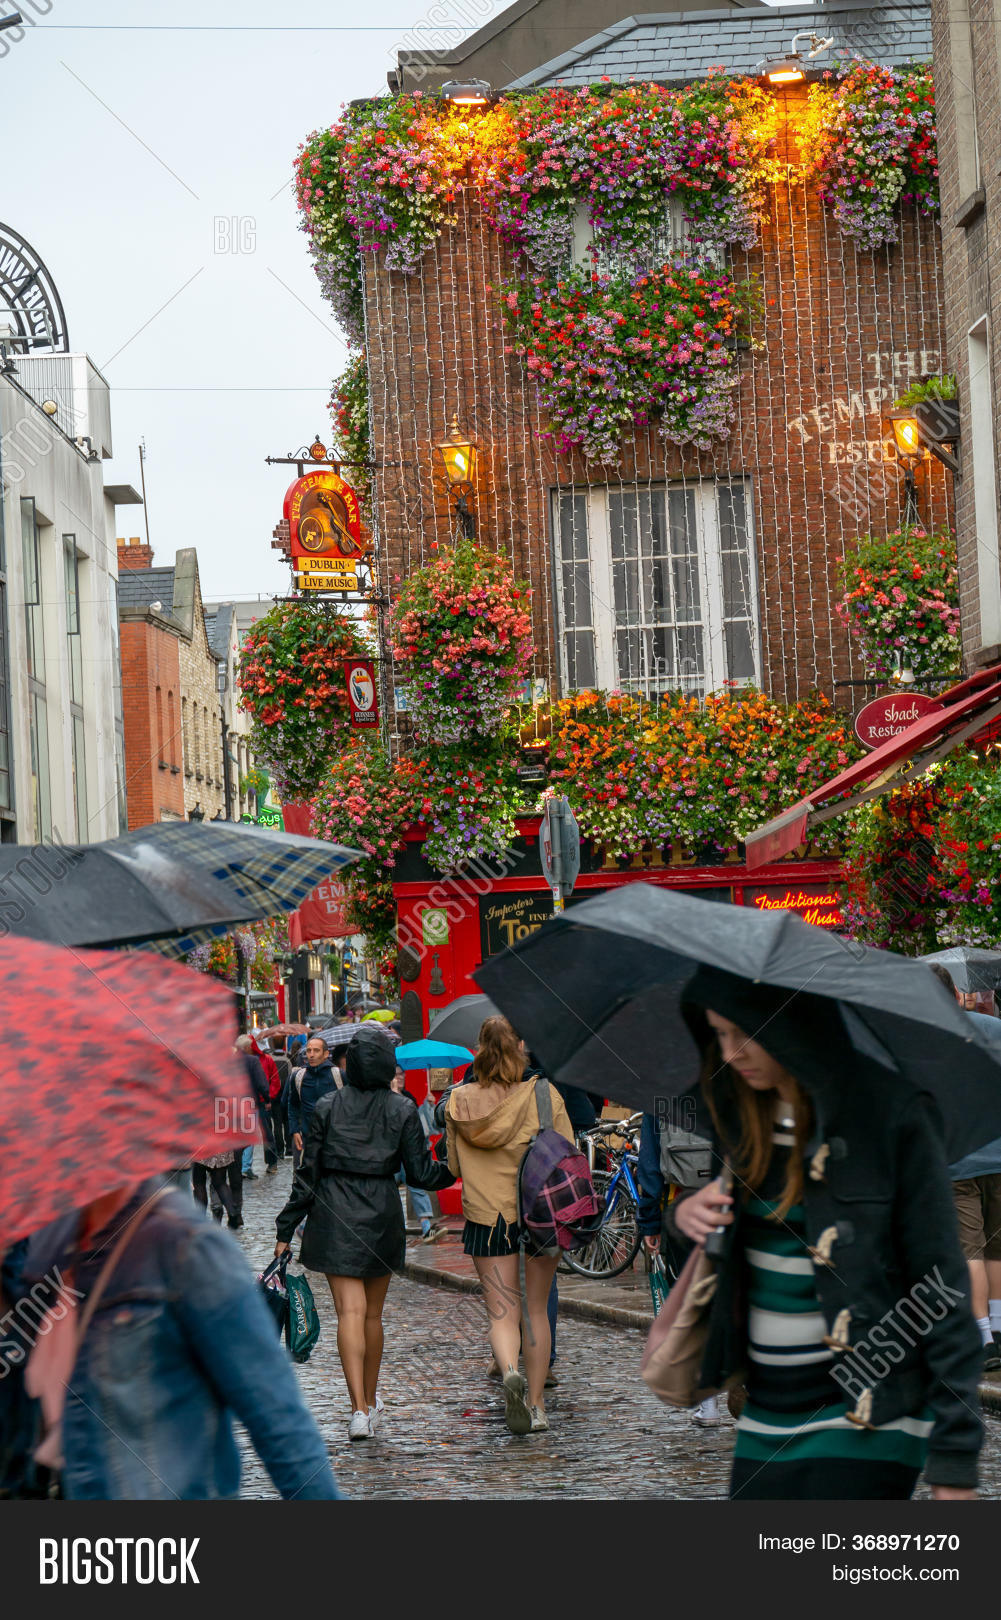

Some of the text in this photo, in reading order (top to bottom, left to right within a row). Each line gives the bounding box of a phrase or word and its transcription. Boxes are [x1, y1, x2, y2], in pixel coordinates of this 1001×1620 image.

[867, 350, 941, 379] THE
[788, 384, 900, 444] TEMP
[291, 491, 304, 521] THE
[343, 492, 358, 524] BAR
[309, 559, 346, 570] DUBLIN
[304, 577, 353, 588] LIVE MUSIC
[529, 913, 548, 921] FINE
